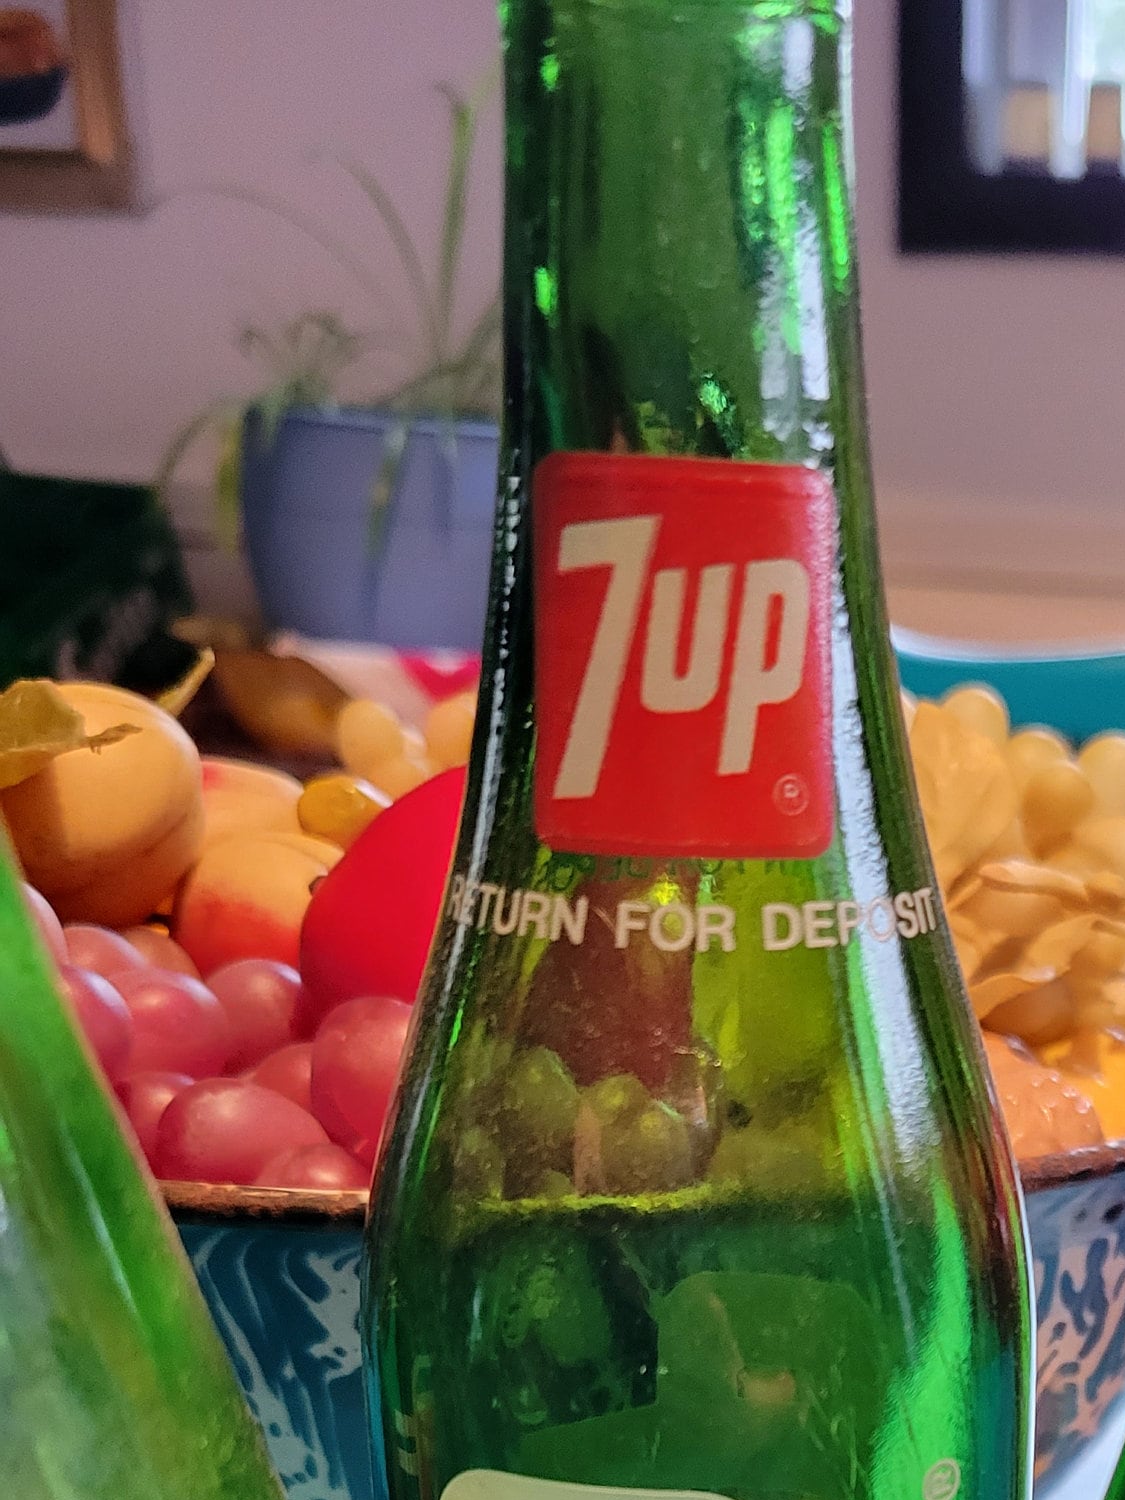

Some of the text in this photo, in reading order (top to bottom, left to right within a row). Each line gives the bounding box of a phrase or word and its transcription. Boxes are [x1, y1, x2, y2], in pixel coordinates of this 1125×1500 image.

[553, 514, 811, 800] 7up
[614, 902, 737, 952] FOR
[761, 886, 937, 951] DEPOSIT
